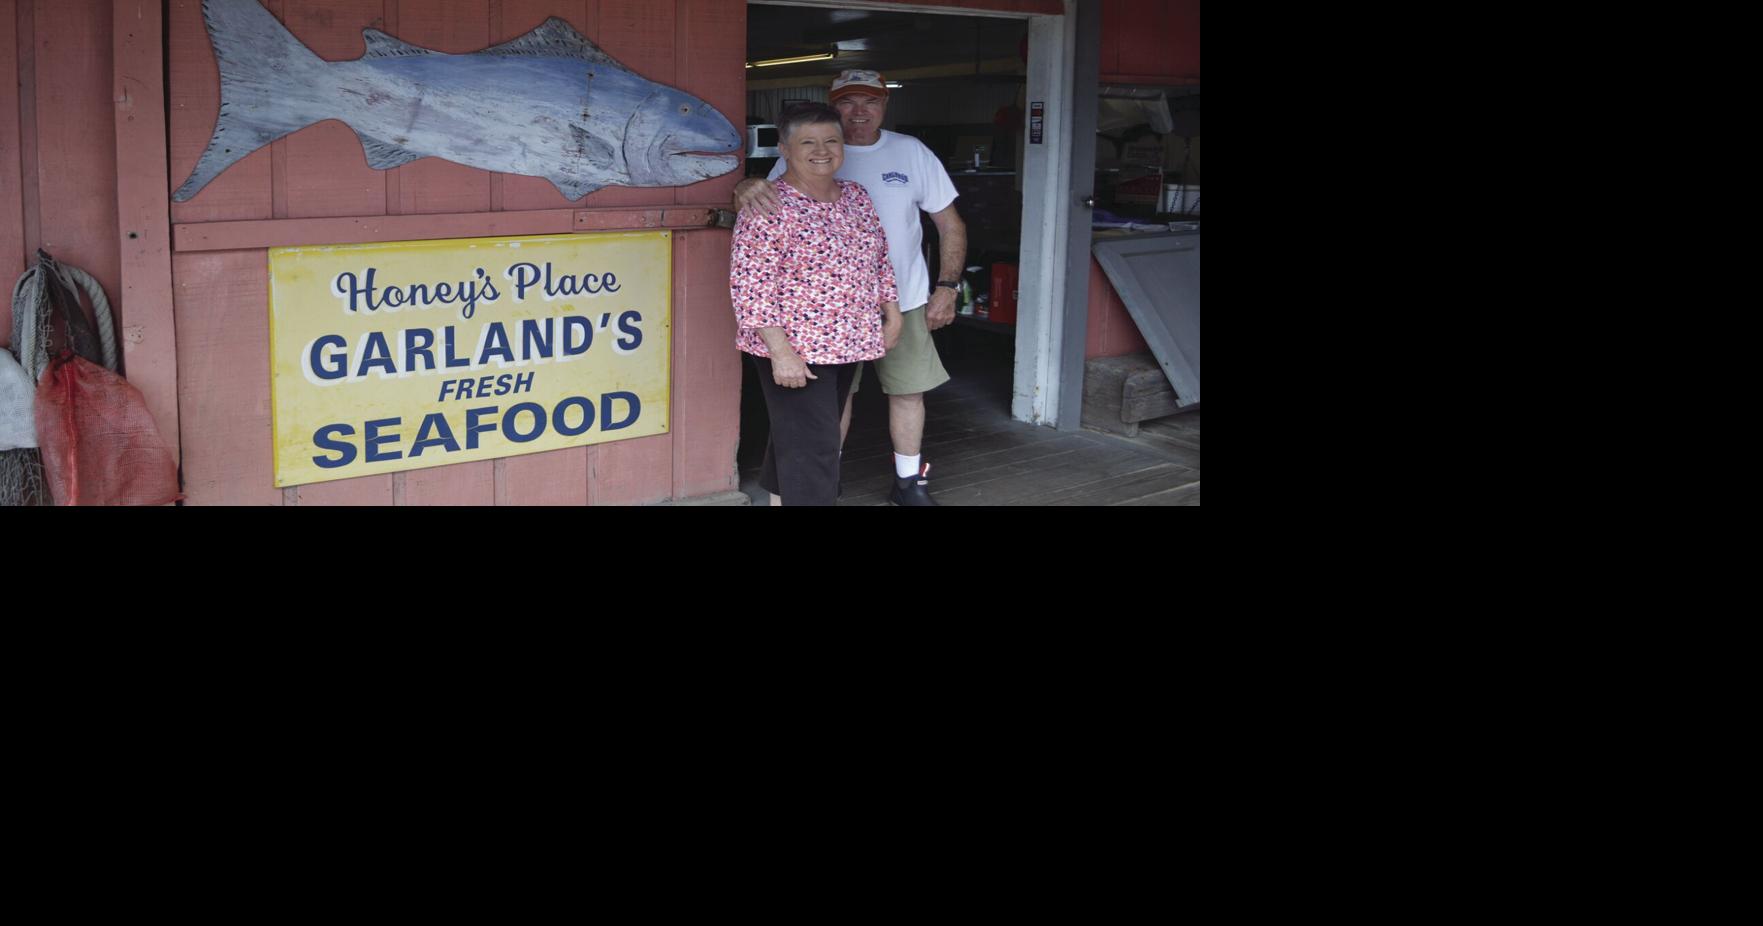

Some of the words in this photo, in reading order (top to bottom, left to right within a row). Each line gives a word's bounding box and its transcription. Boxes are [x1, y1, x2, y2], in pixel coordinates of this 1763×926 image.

[336, 267, 500, 319] Honey's
[508, 262, 621, 300] Place
[310, 310, 643, 380] GARLAND'S
[438, 371, 535, 402] FRESH
[312, 391, 641, 469] SEAFOOD
